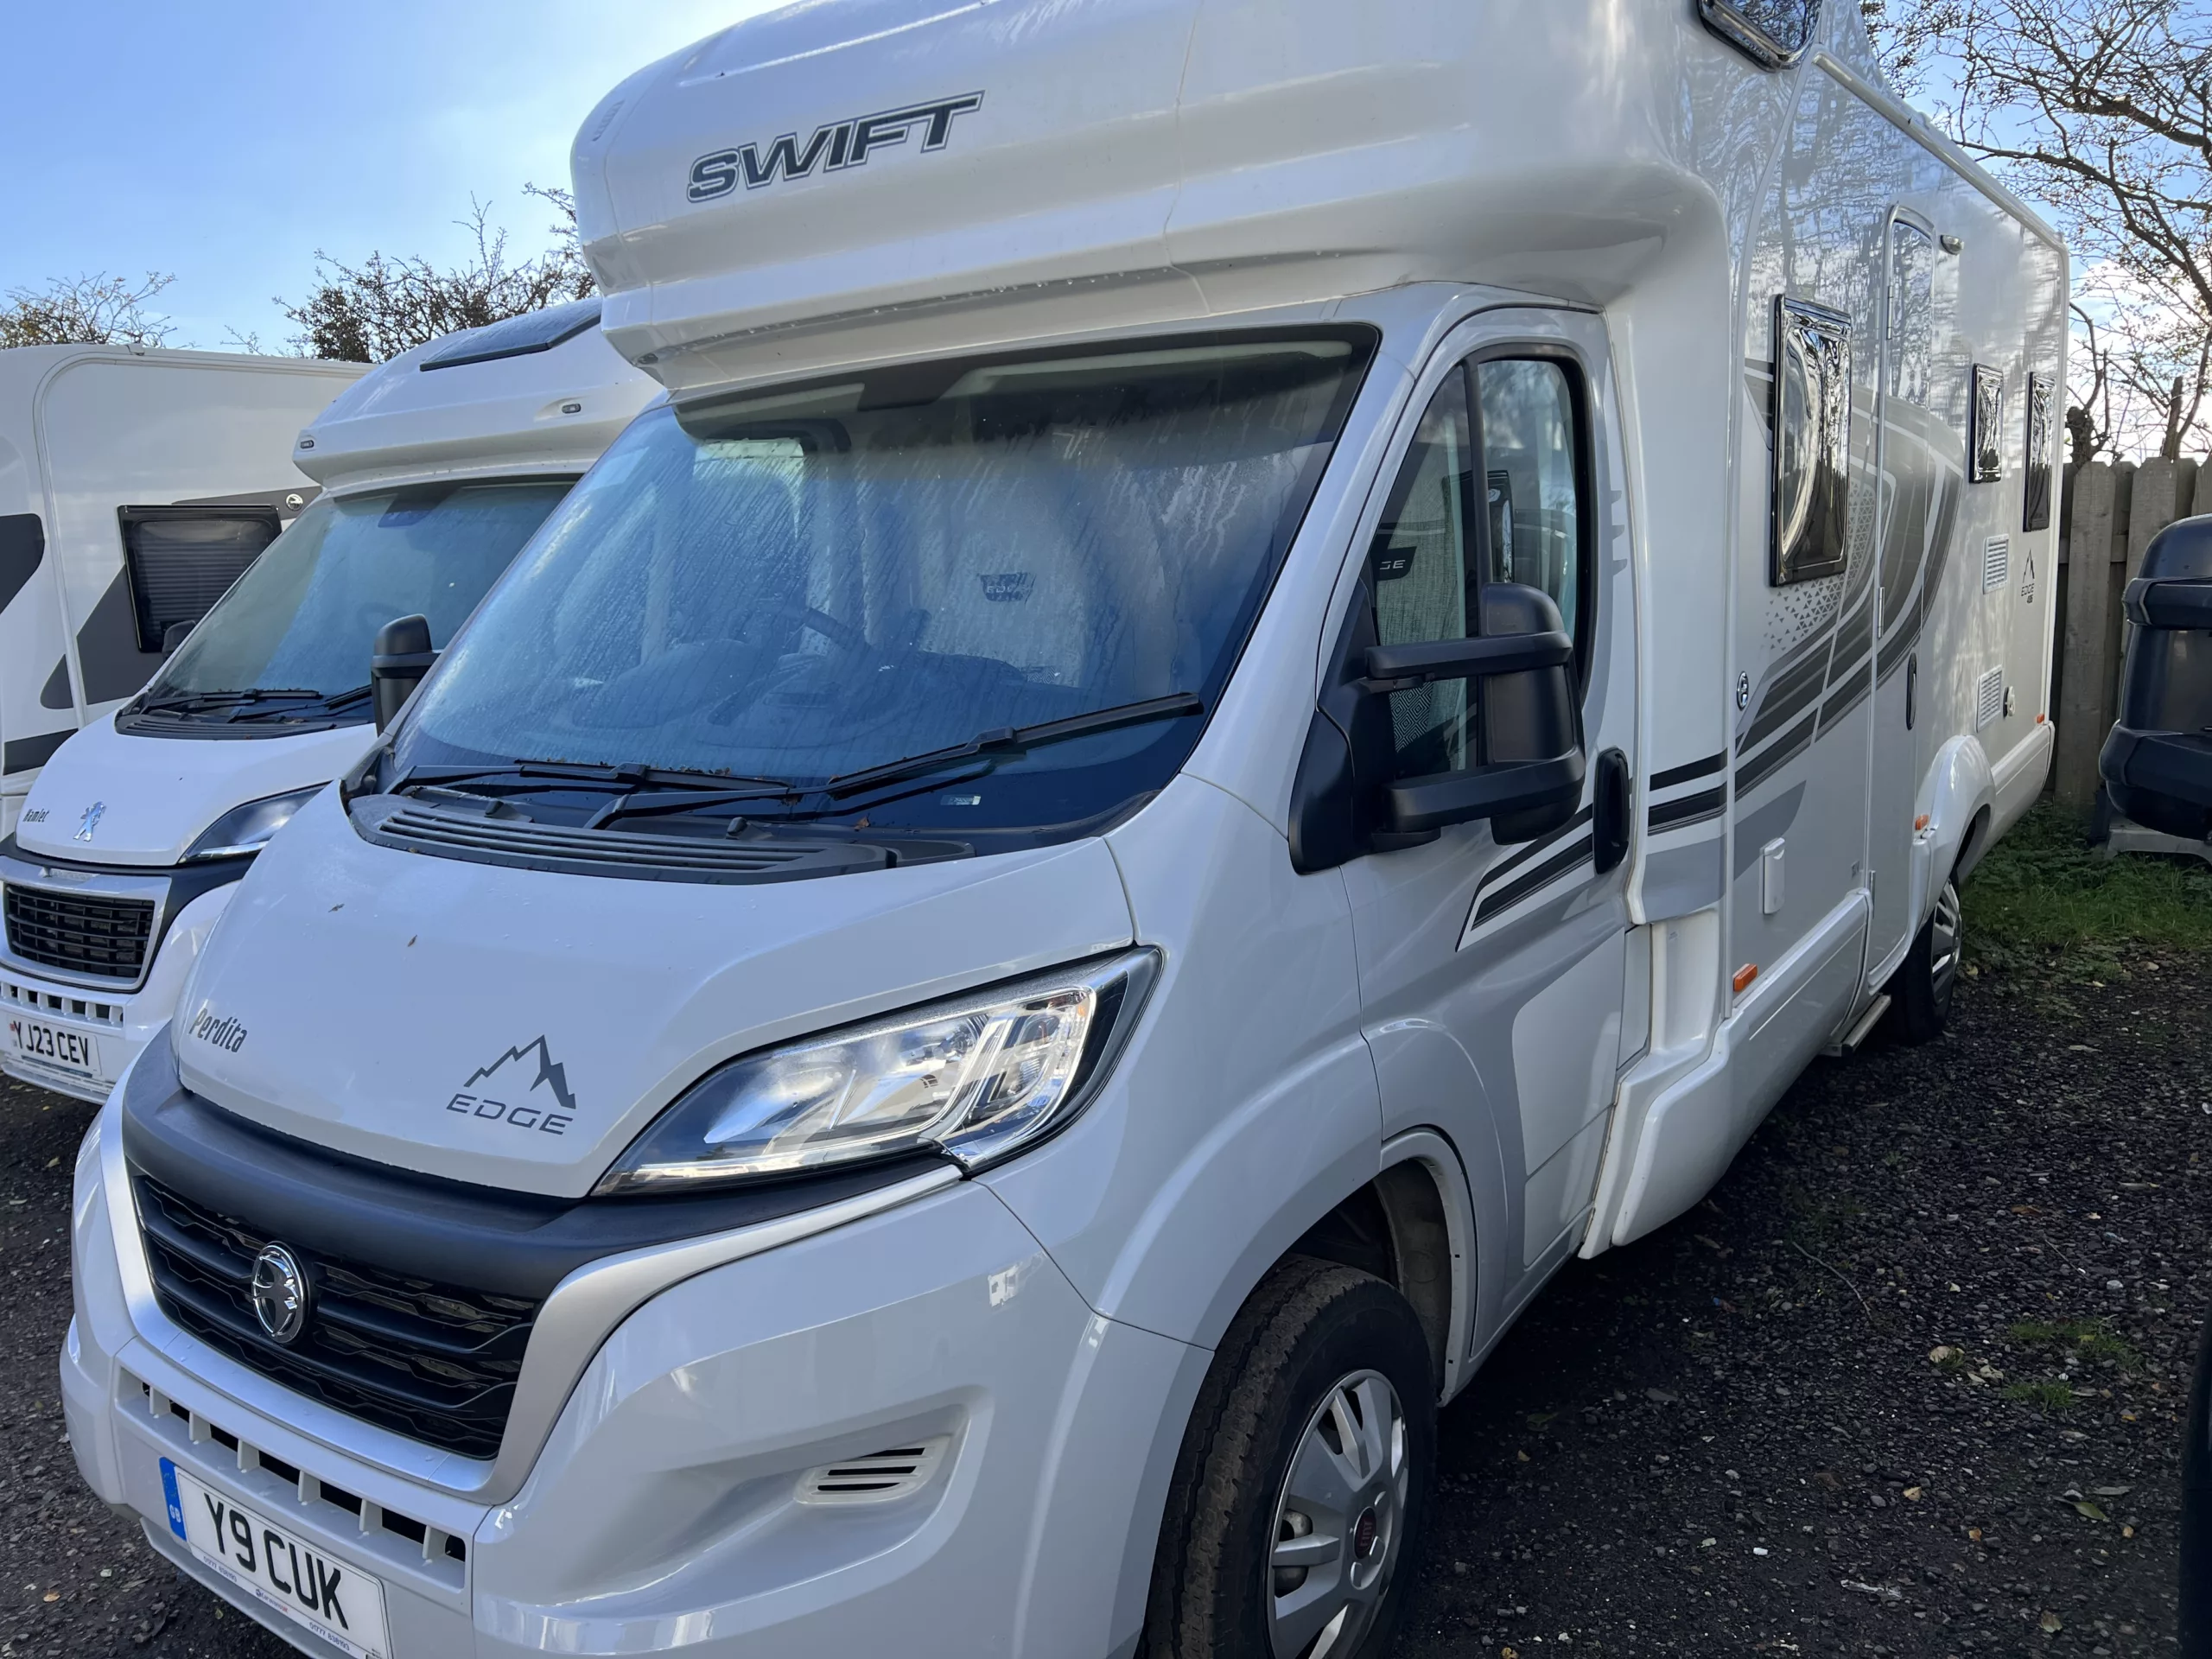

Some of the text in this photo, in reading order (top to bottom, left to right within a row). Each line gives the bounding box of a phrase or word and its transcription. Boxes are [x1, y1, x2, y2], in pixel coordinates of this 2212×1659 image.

[687, 90, 986, 203] SWIFT
[2021, 582, 2035, 596] EDGE
[22, 808, 50, 823] Hamlet
[13, 1020, 88, 1066] YJ23 CEV
[188, 1007, 247, 1052] Perdita
[446, 1093, 573, 1135] EDGE
[168, 1503, 181, 1523] GB
[203, 1492, 349, 1631] Y9 CUK
